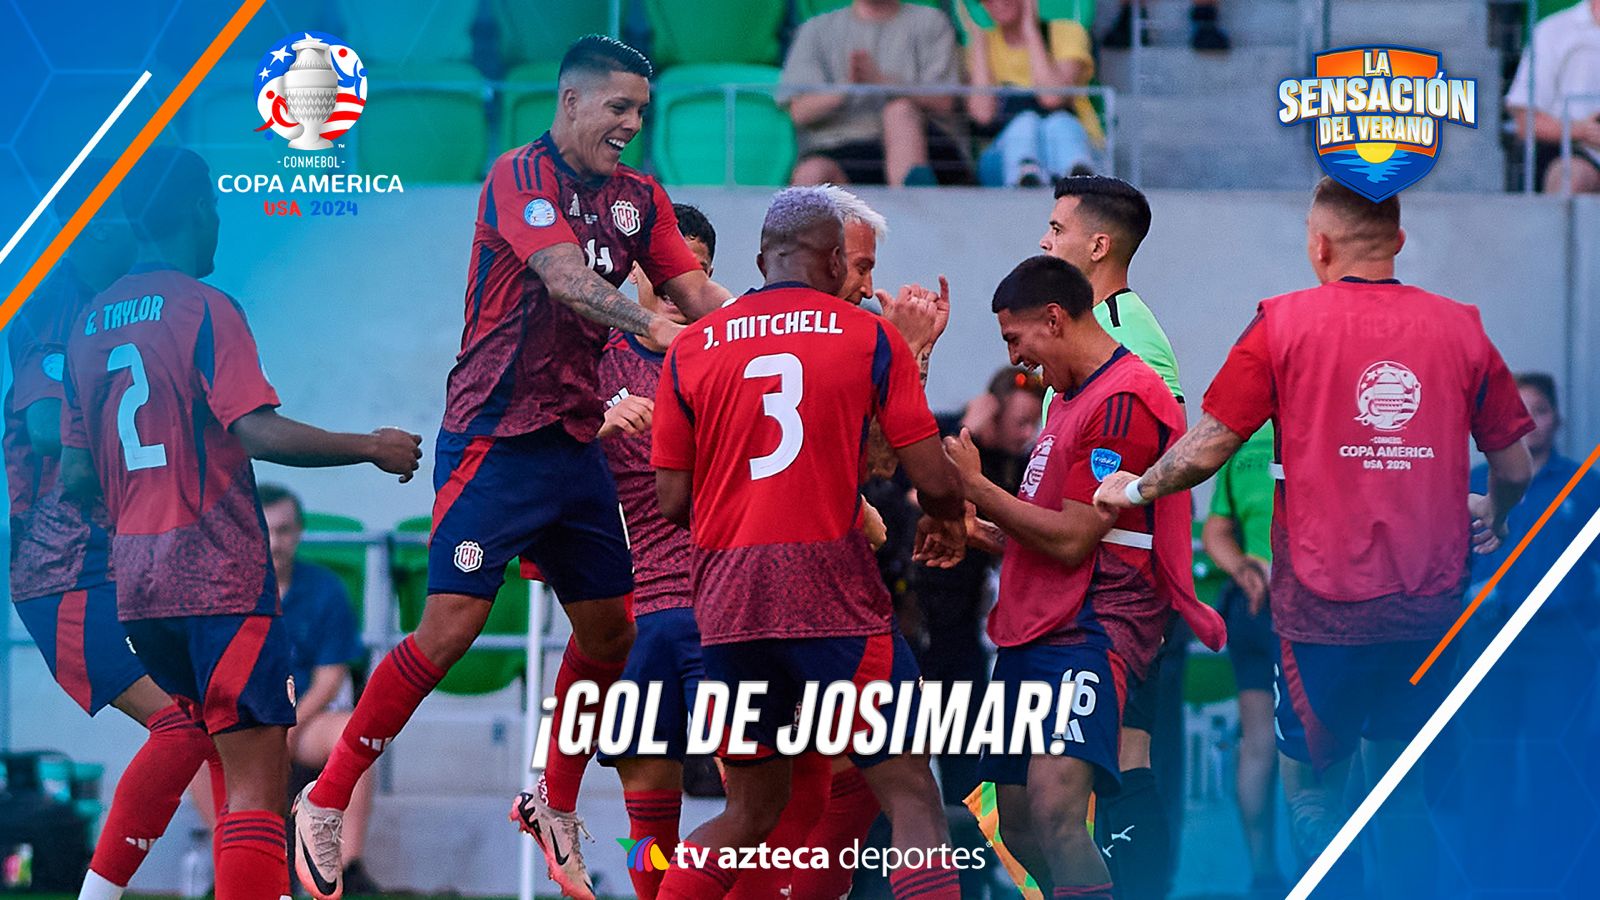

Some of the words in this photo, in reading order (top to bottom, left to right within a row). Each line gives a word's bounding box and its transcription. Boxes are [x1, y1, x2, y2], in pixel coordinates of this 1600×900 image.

[103, 295, 164, 331] TAYLOR
[703, 326, 720, 350] J.
[726, 310, 843, 342] MITCHELL
[106, 342, 168, 472] 2
[743, 352, 804, 481] 3
[1339, 445, 1374, 457] COPA
[1376, 446, 1435, 458] AMERICA
